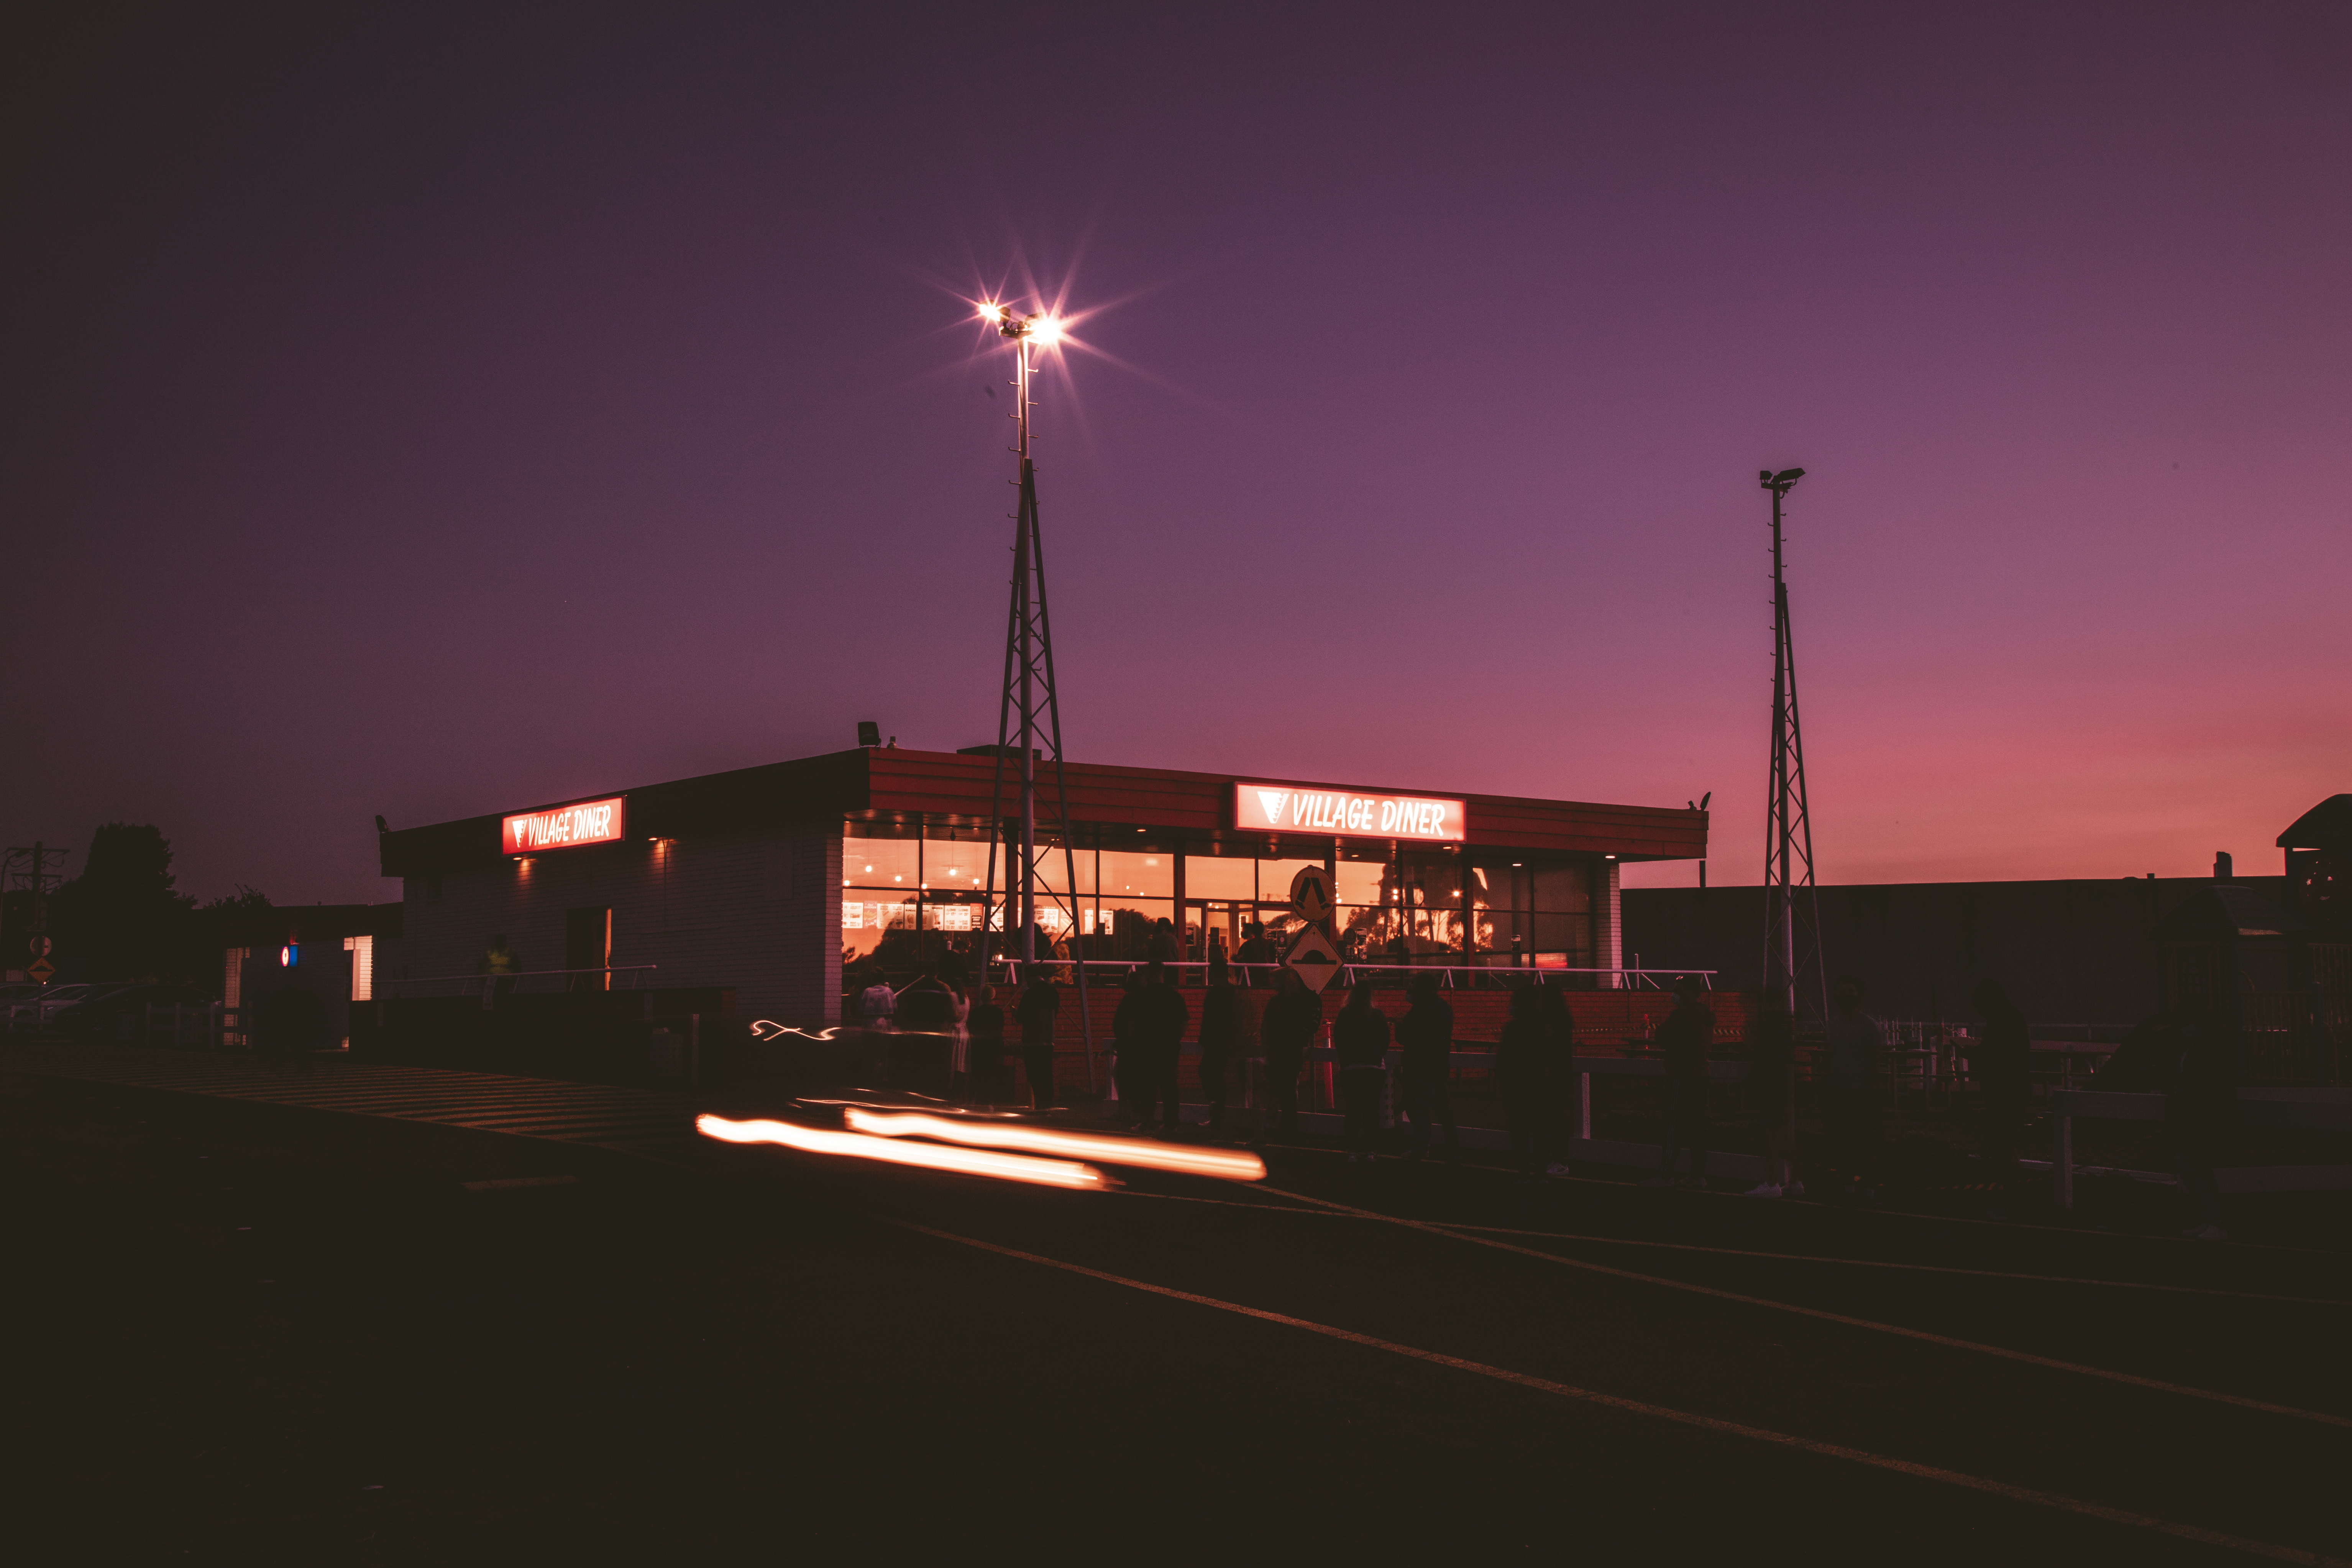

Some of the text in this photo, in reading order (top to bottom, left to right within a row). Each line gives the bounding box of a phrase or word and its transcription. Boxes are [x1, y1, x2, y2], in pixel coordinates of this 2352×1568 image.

[529, 805, 611, 846] VILLAGE DINER
[1293, 793, 1445, 837] VILLAGE DINER
